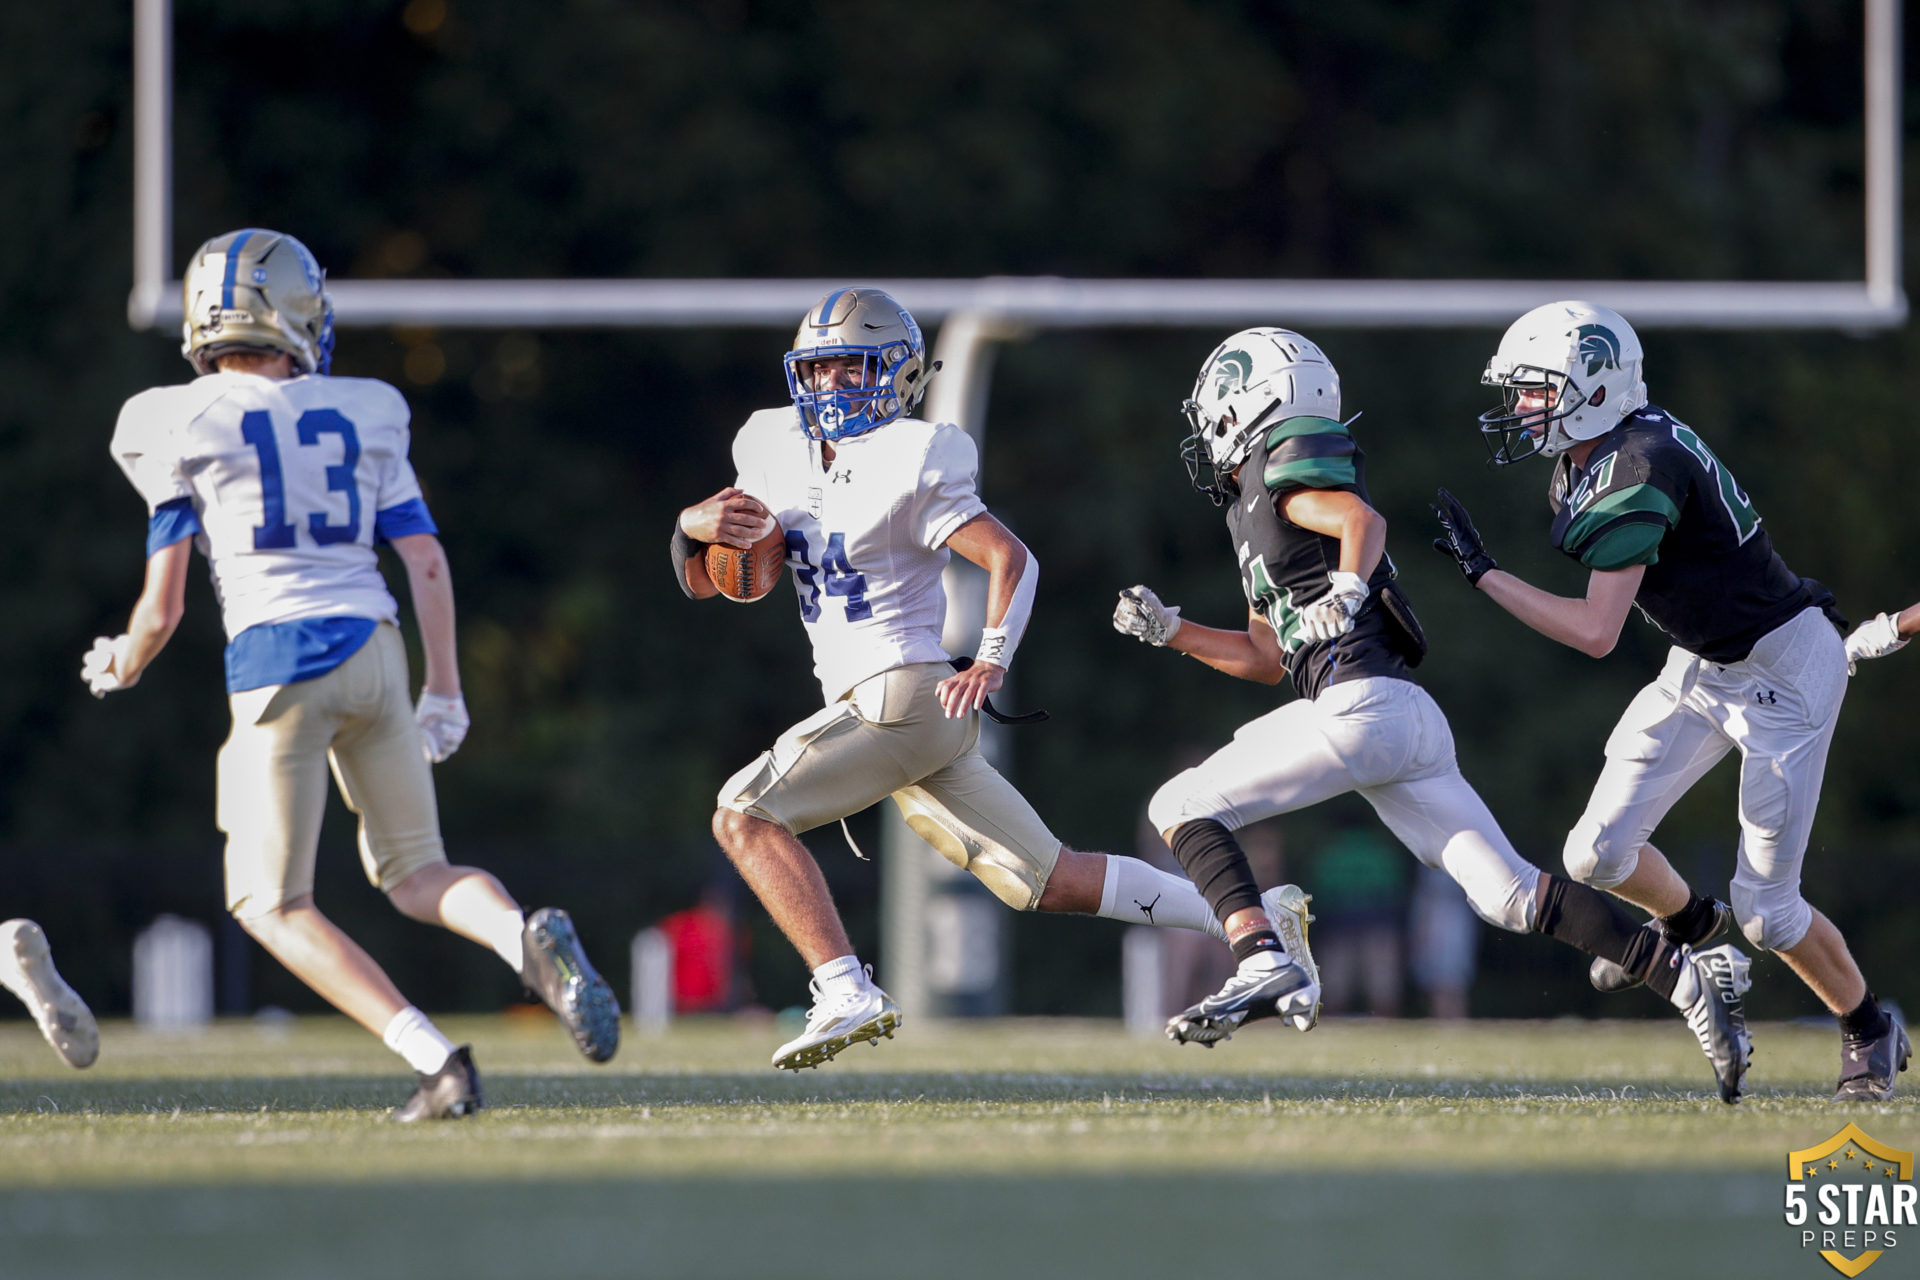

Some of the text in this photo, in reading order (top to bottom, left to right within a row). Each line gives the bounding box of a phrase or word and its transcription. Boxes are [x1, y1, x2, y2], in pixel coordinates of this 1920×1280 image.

[241, 408, 361, 549] 13
[1567, 450, 1618, 520] 27
[1669, 421, 1762, 547] 2
[784, 529, 873, 623] 34
